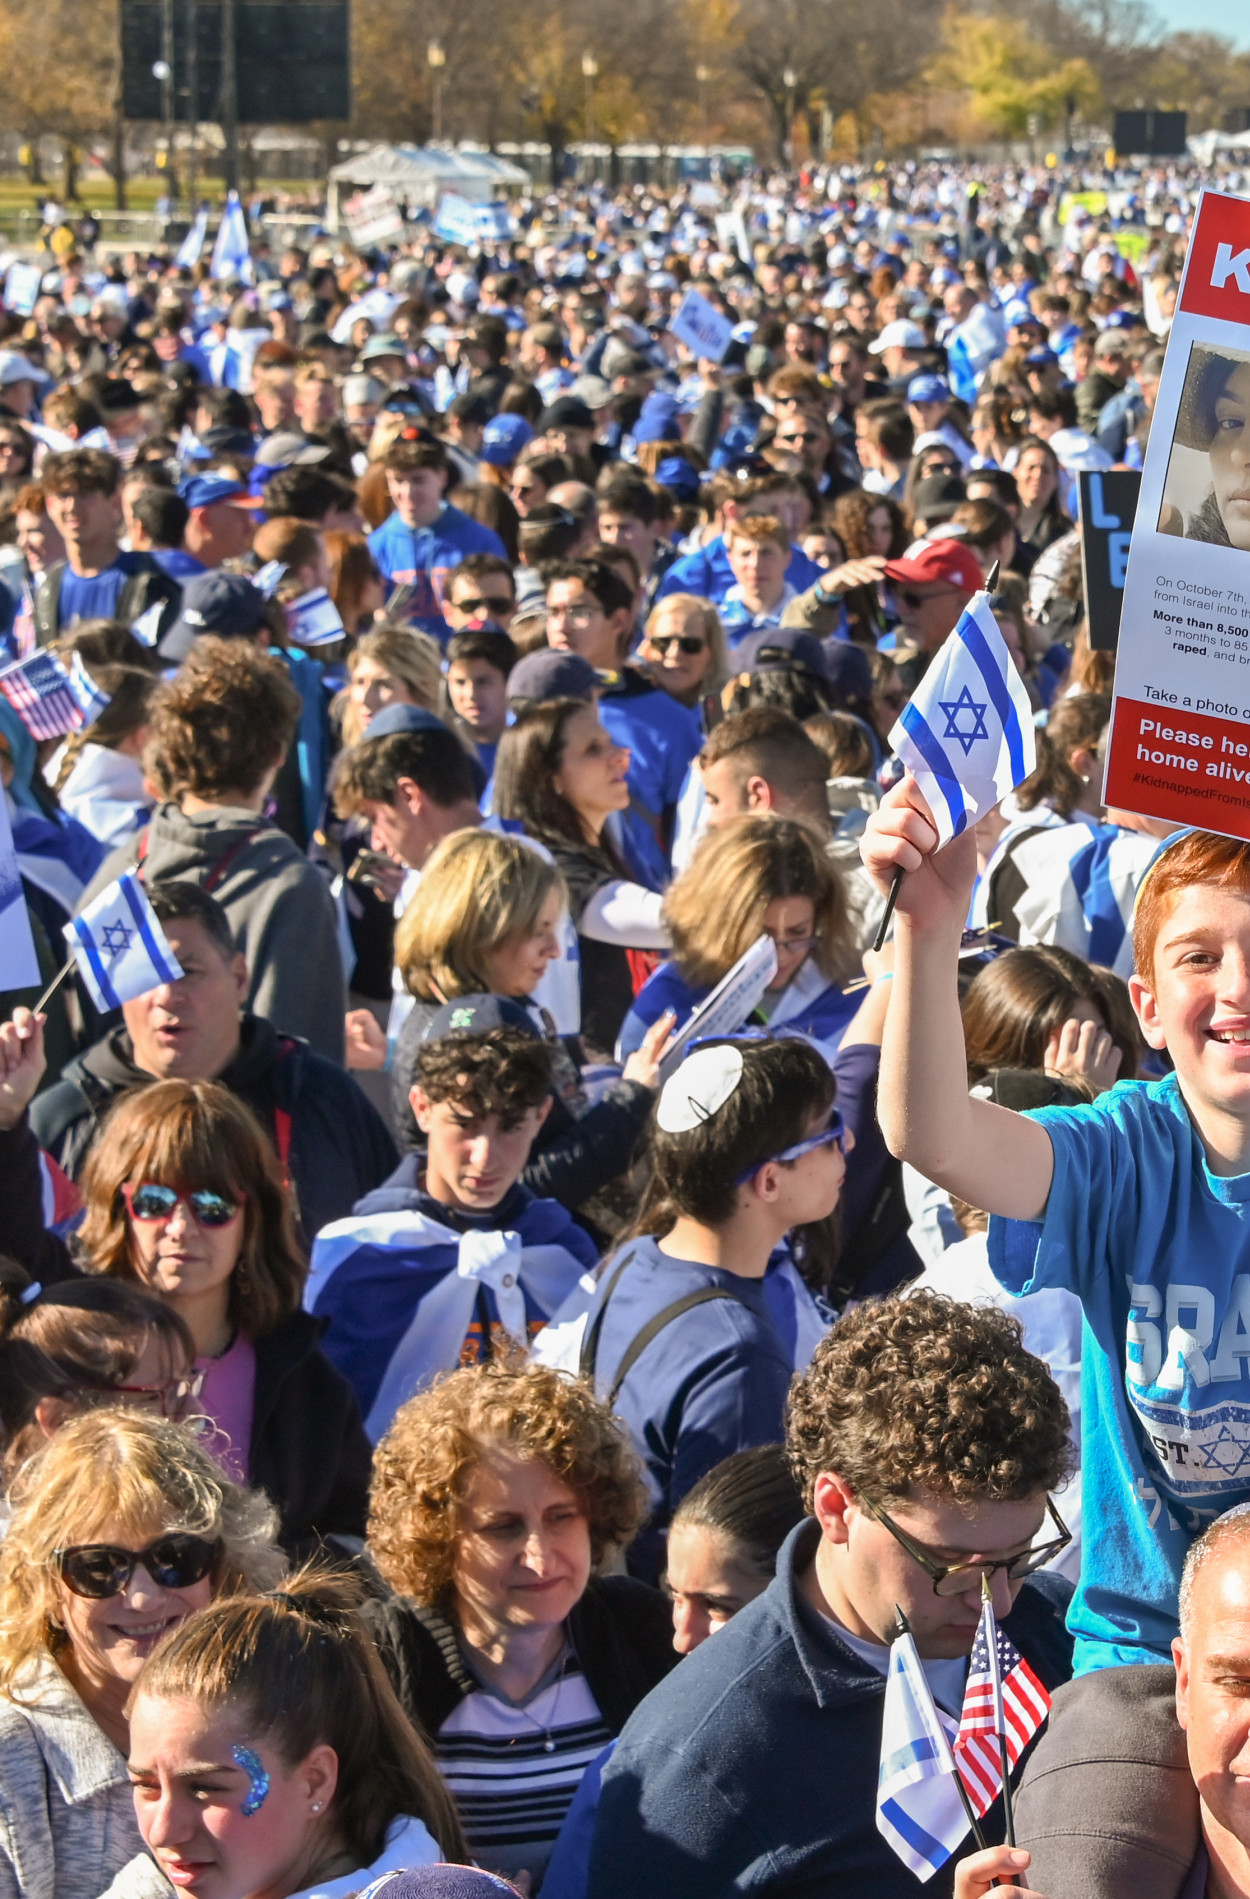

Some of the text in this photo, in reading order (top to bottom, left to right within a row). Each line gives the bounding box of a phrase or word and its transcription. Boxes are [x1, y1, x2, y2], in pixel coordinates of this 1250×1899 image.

[1154, 589, 1179, 604] from
[1183, 595, 1214, 611] Israel
[1216, 603, 1238, 616] into
[1156, 575, 1173, 588] On
[1176, 580, 1223, 599] October
[1227, 590, 1247, 605] 7th,
[1153, 609, 1183, 625] More
[1186, 617, 1213, 631] than
[1216, 623, 1249, 638] 8,500
[1164, 626, 1172, 635] 3
[1175, 630, 1217, 645] months
[1220, 637, 1231, 648] to
[1234, 641, 1248, 651] 85
[1172, 642, 1209, 657] raped,
[1213, 650, 1235, 662] and
[1143, 685, 1178, 704] Take
[1182, 695, 1192, 706] a
[1196, 698, 1238, 717] photo
[1139, 717, 1214, 750] Please
[1136, 743, 1199, 772] home
